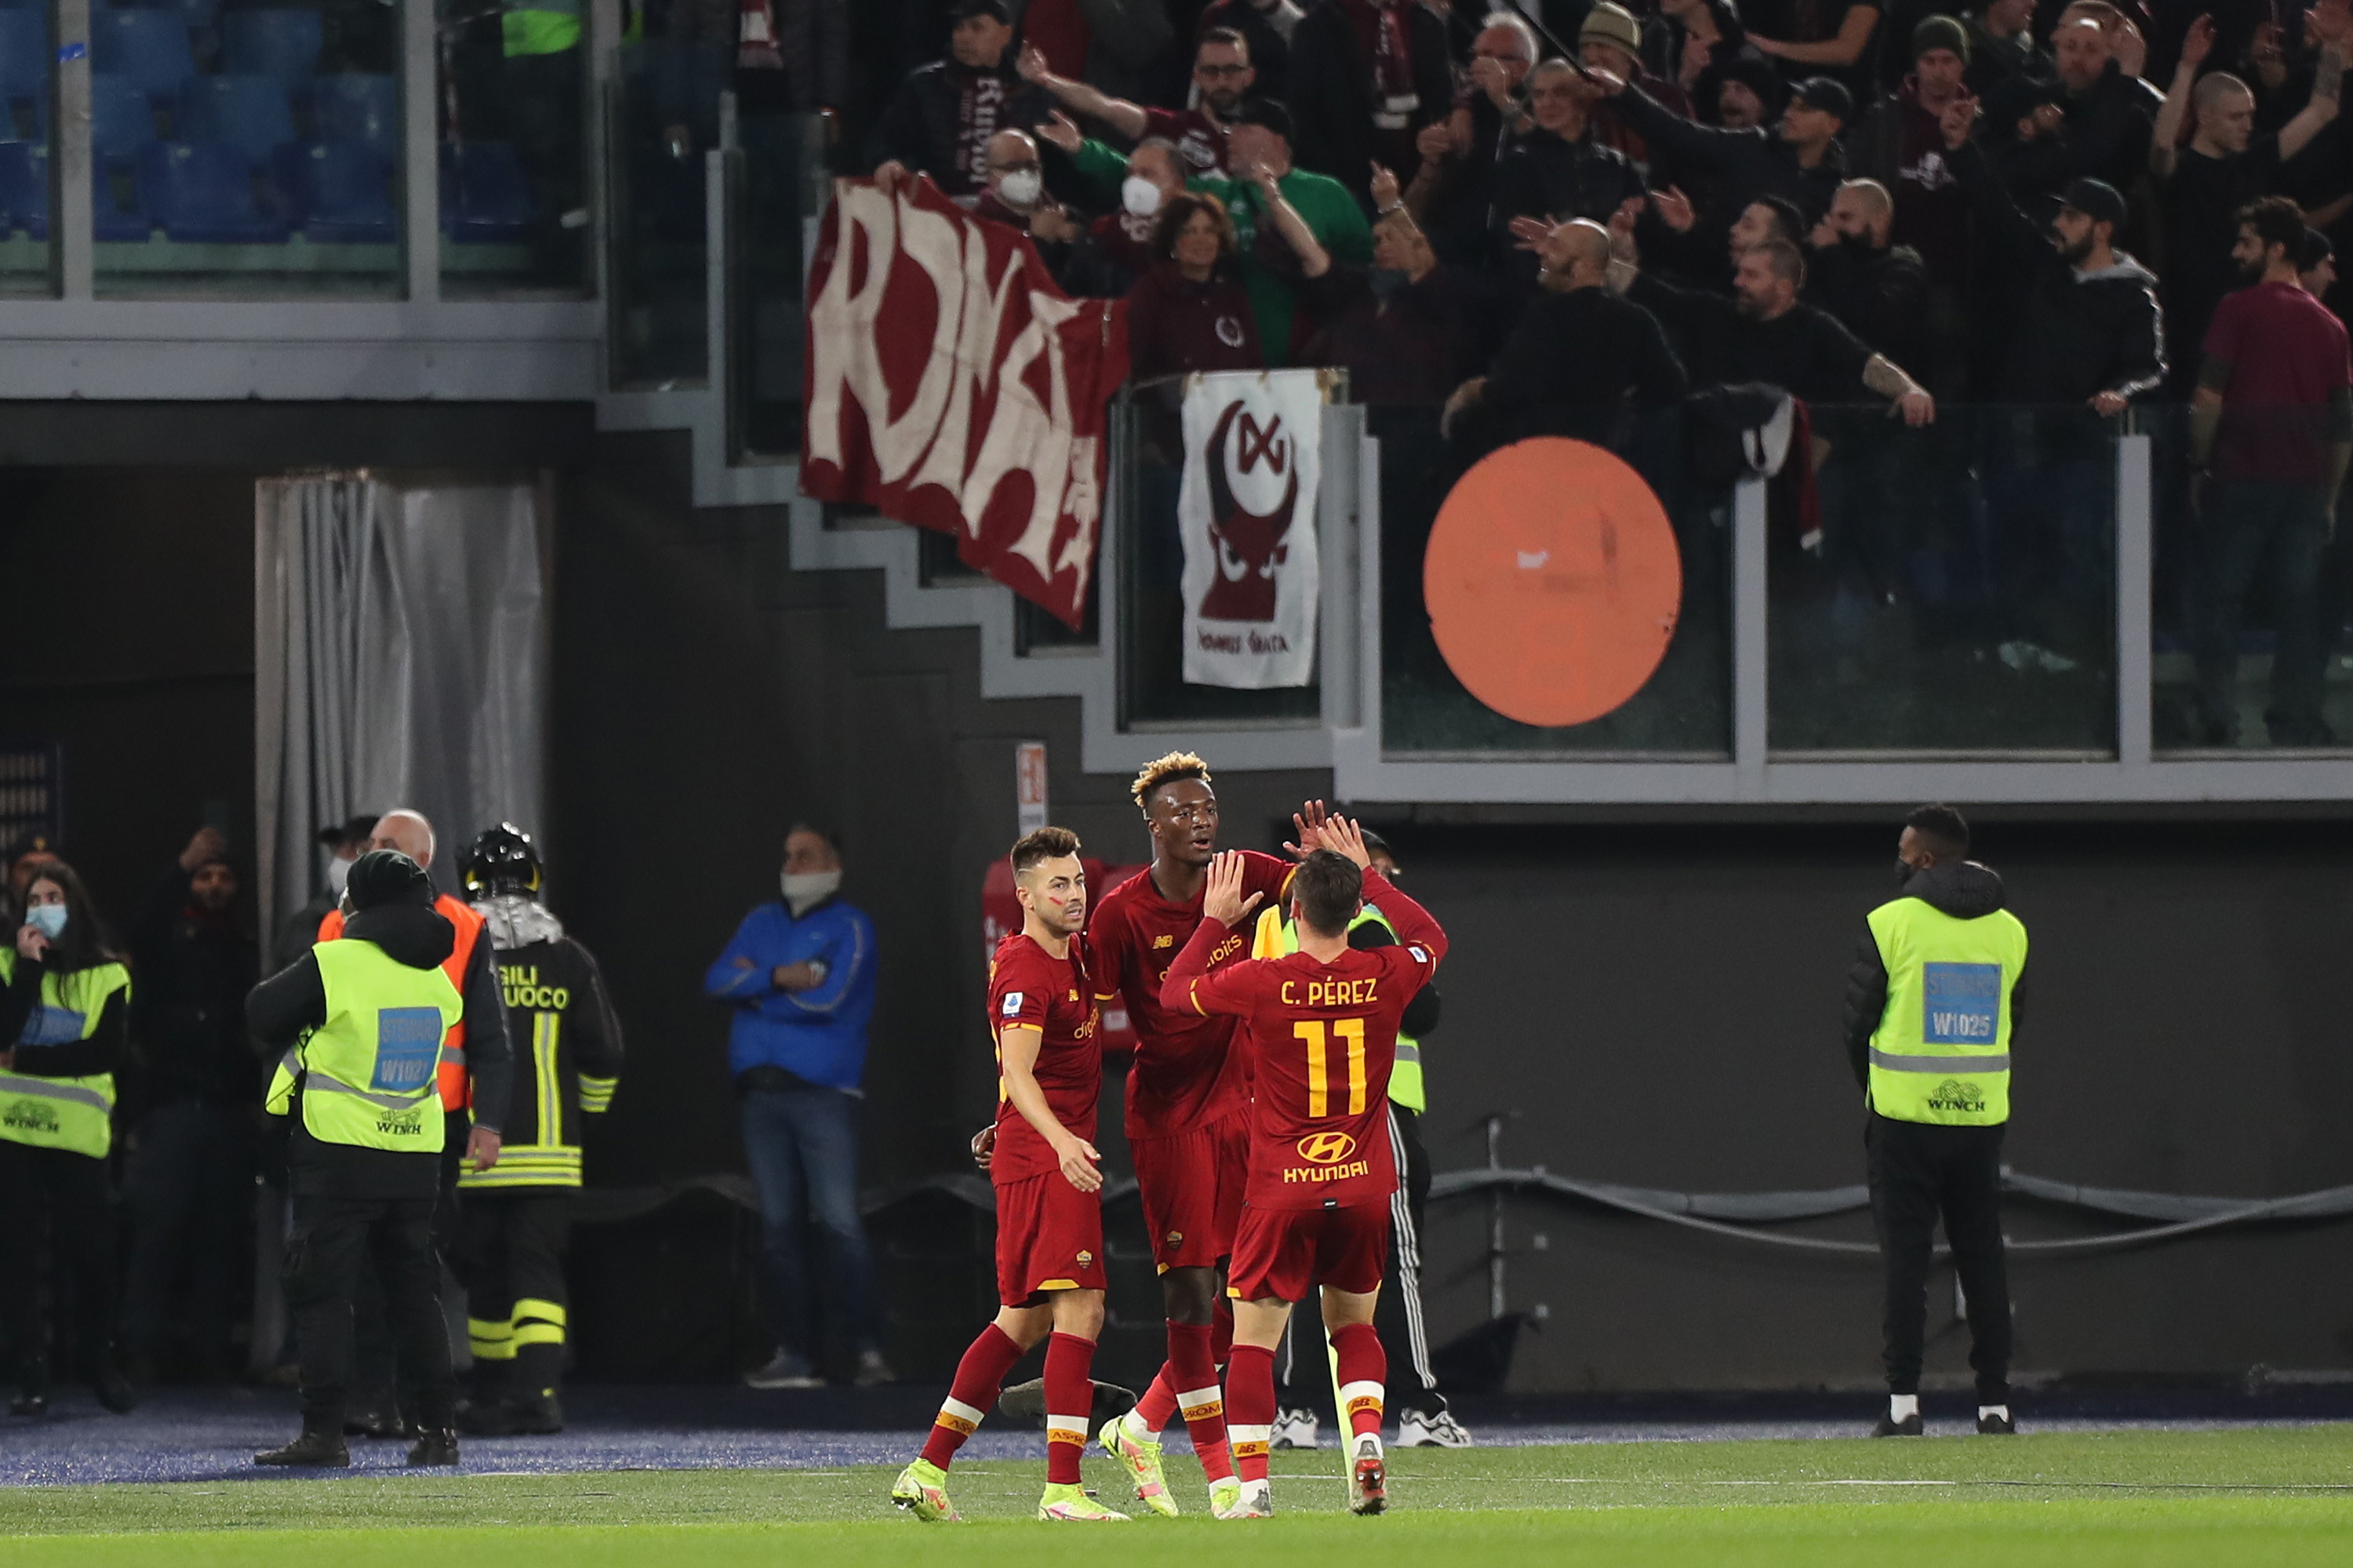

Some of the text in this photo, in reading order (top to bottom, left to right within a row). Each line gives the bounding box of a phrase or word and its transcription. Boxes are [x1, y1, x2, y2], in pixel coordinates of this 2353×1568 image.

[503, 986, 570, 1010] UOCO
[1282, 975, 1377, 1005] C. PÉREZ
[1933, 1012, 1990, 1037] W1025
[1293, 1018, 1367, 1118] 11
[1929, 1100, 1985, 1111] WINCH
[1284, 1160, 1369, 1183] HYUNDAI
